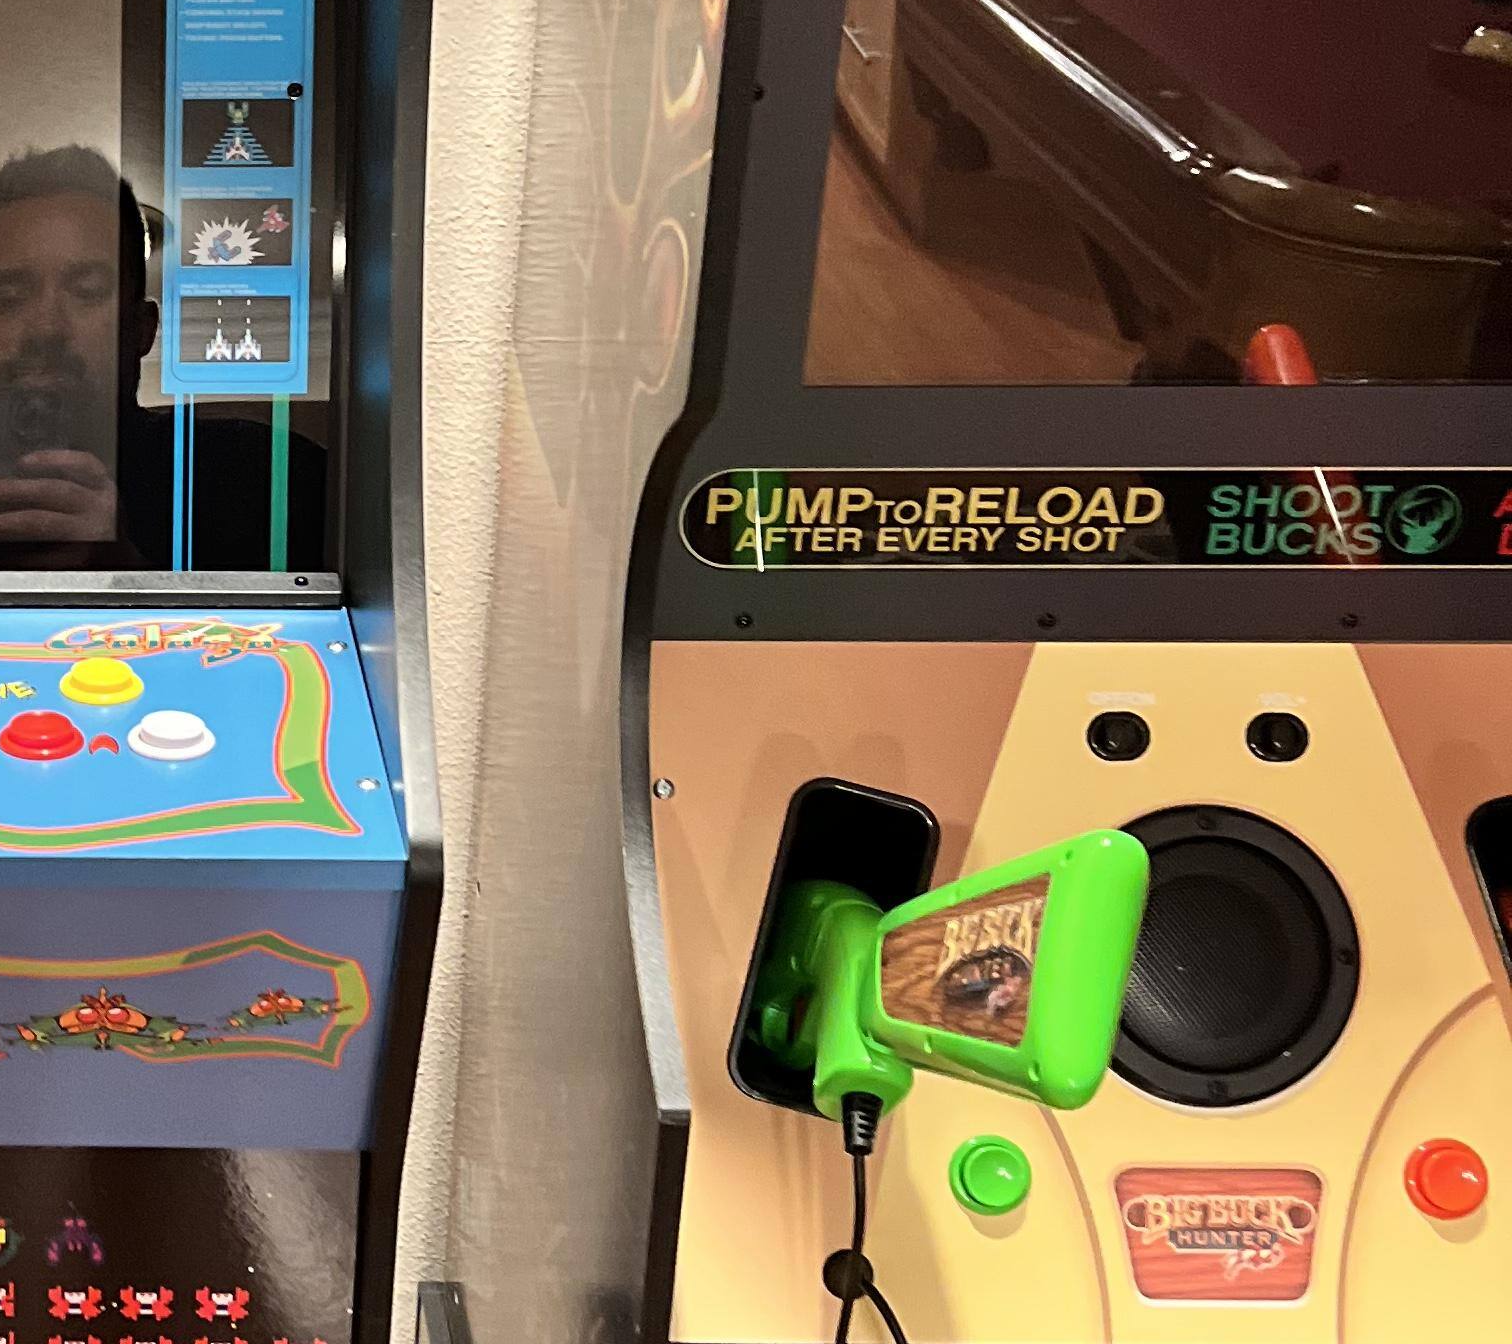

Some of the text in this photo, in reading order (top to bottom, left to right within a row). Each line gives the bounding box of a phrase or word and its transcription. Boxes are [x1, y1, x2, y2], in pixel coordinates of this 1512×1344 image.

[925, 486, 1165, 525] RELOAD
[1206, 484, 1395, 519] SHOOT
[734, 526, 1127, 553] AFTER EVERY SHOT
[1205, 522, 1384, 556] BUCKS
[1143, 1198, 1303, 1244] BIG BUCK
[1177, 1231, 1272, 1246] HUNTER
